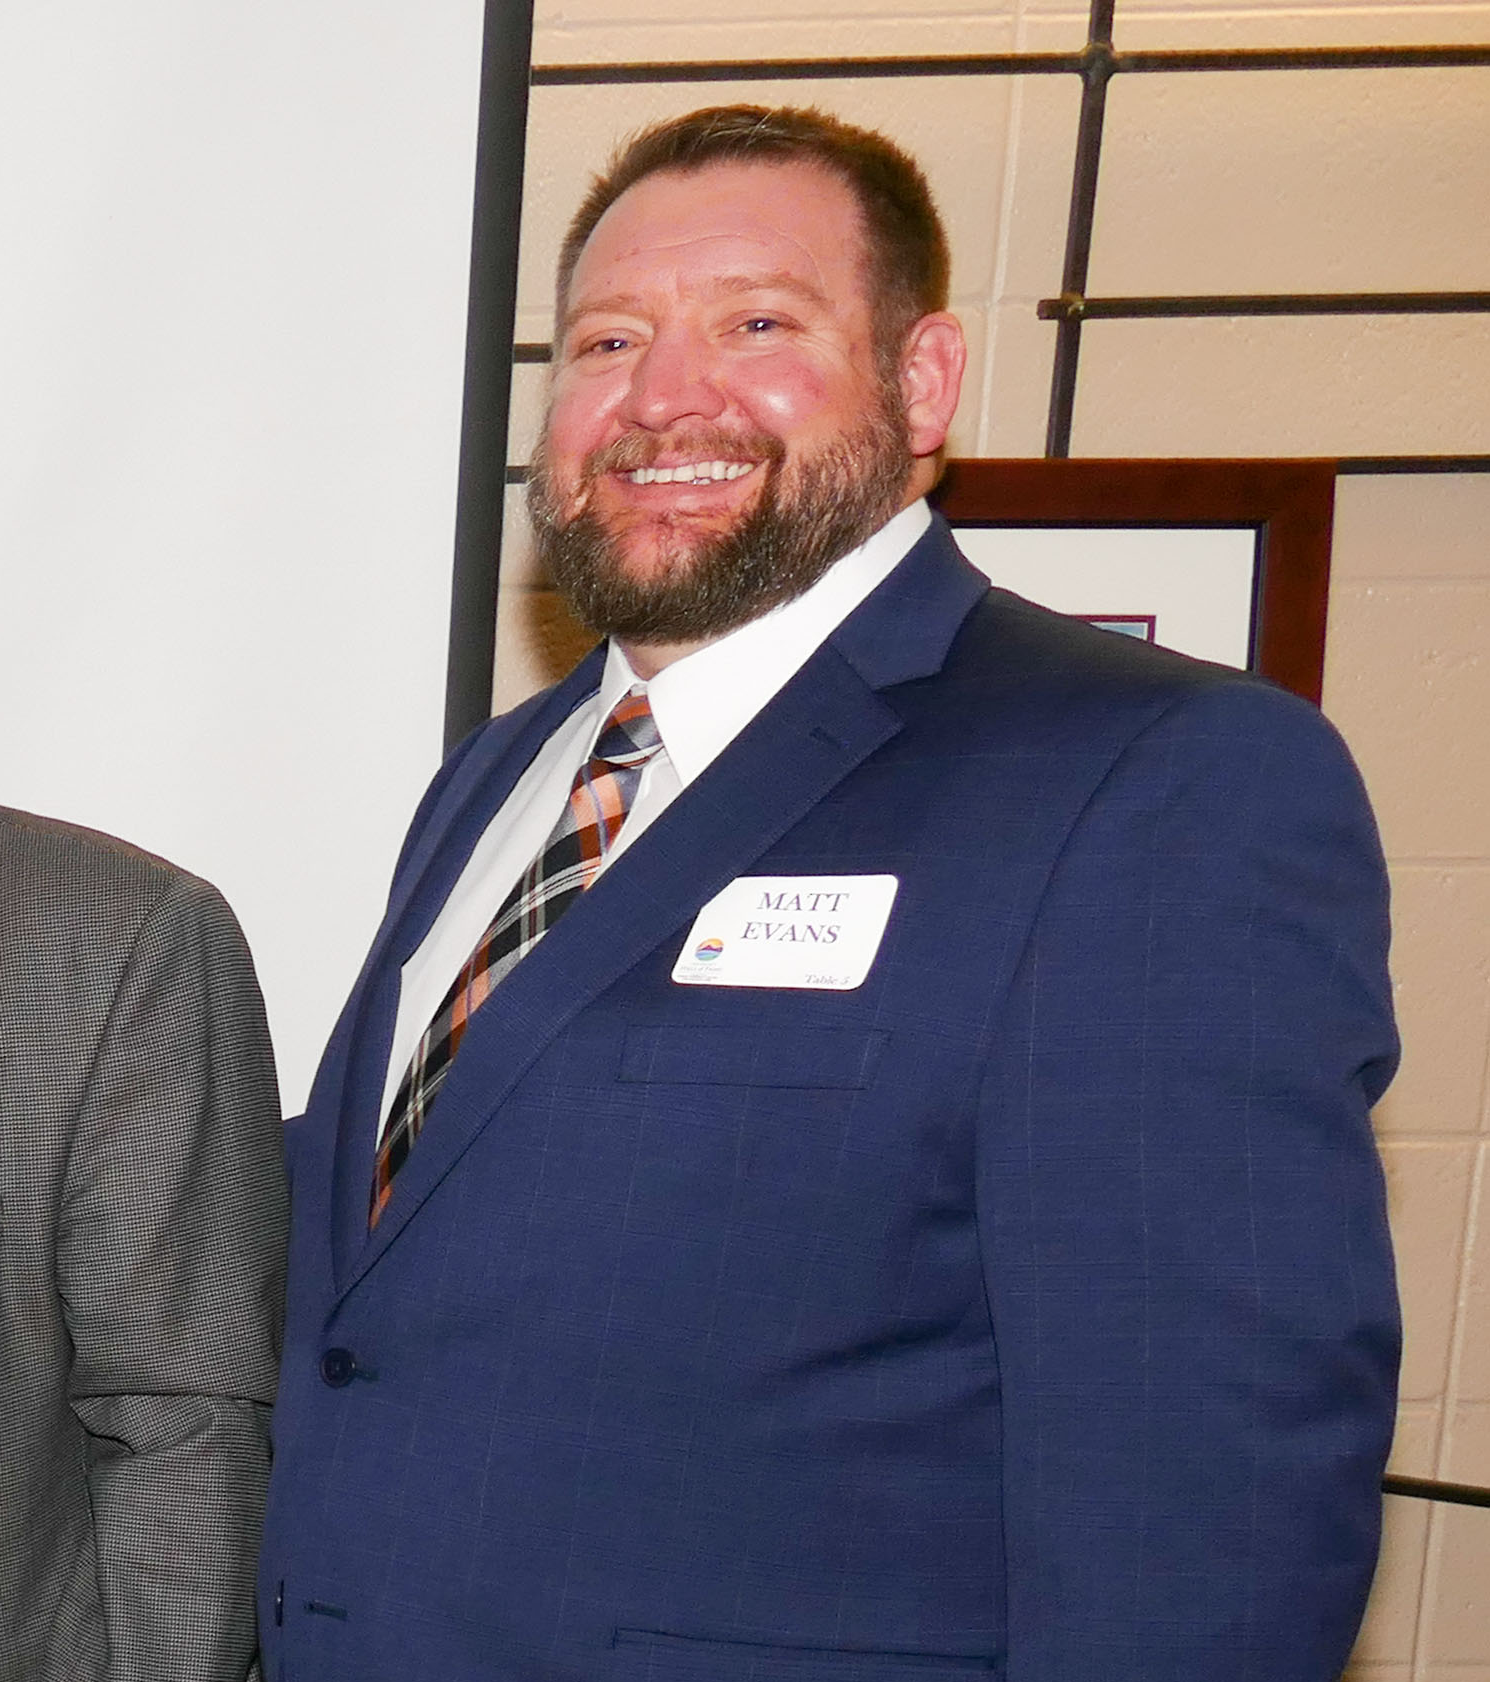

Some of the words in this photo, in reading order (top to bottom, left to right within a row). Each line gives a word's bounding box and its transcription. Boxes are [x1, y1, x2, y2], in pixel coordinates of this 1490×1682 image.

[757, 892, 850, 912] MATT
[740, 922, 841, 944] EVANS
[805, 974, 837, 985] Table
